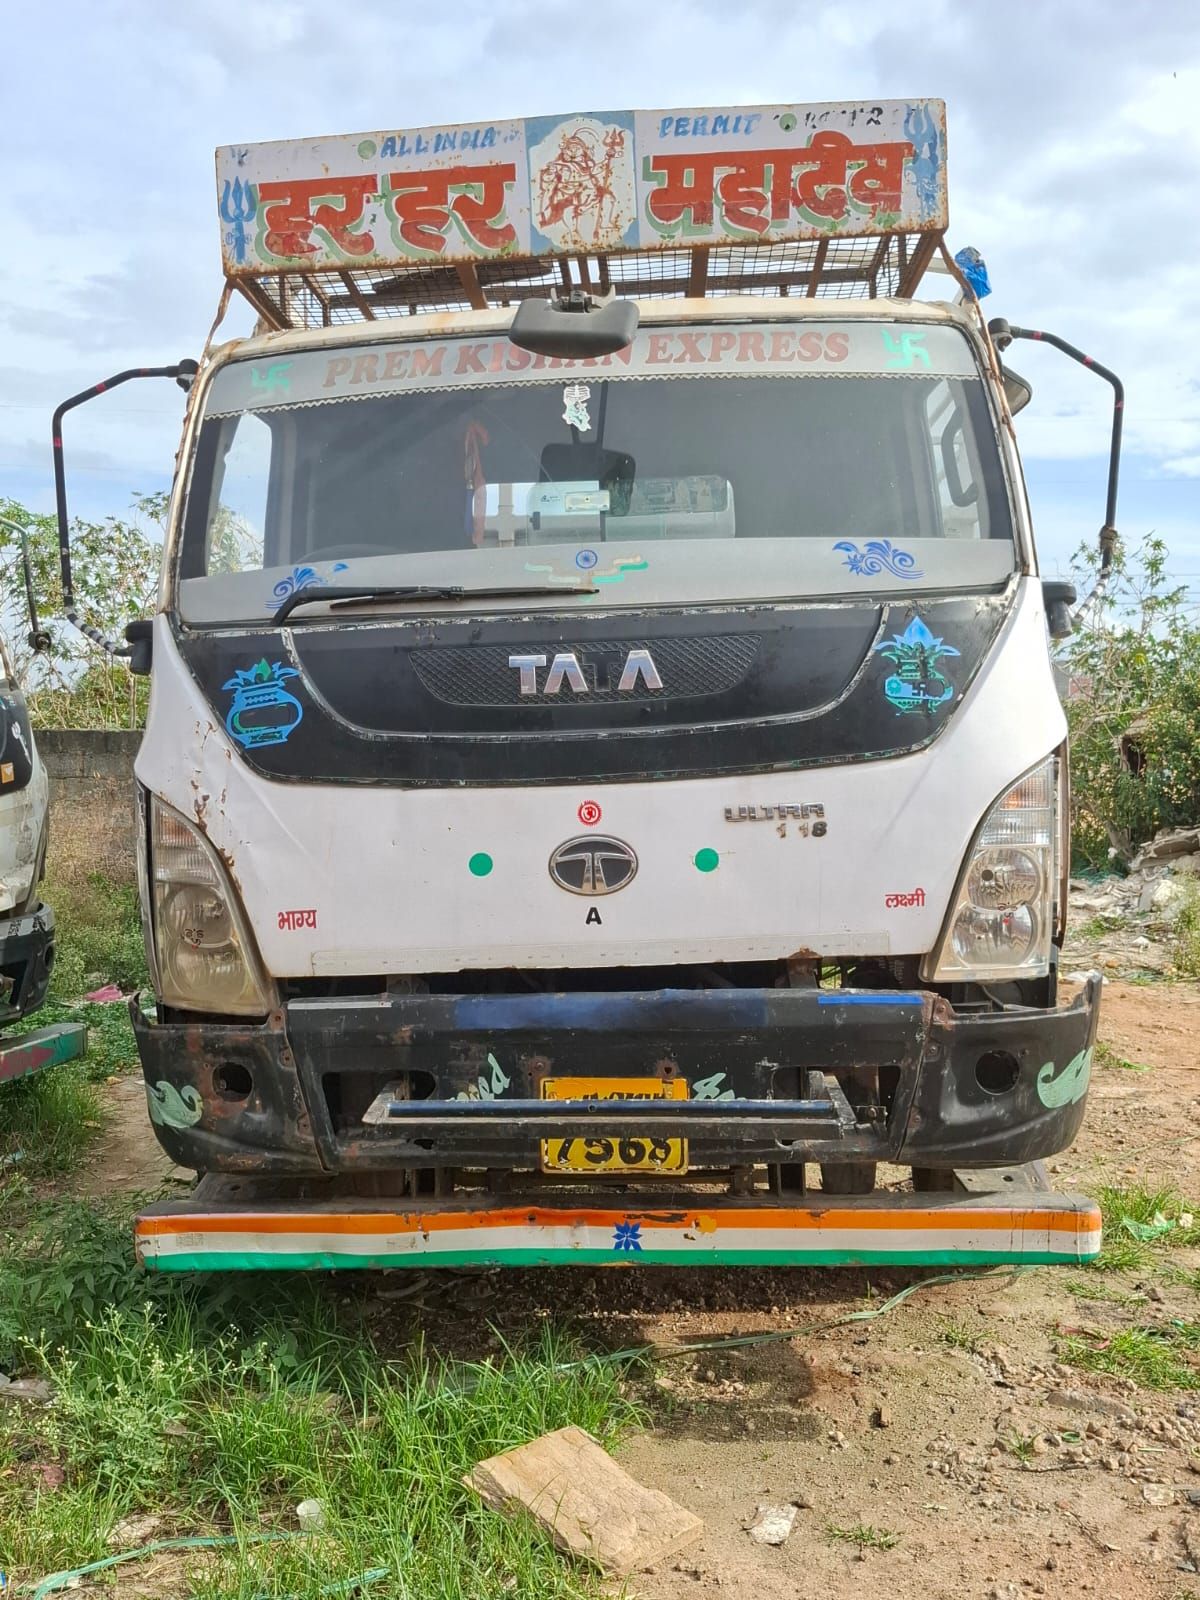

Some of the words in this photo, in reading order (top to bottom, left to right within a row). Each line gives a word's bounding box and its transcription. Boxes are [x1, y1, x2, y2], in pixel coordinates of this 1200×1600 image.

[380, 134, 428, 158] ALL
[433, 126, 497, 154] INDIA
[658, 113, 763, 138] PERMIT
[256, 173, 379, 260] हर
[388, 162, 518, 254] हर
[648, 130, 916, 236] महादेव
[322, 346, 448, 388] PREM
[644, 331, 851, 365] EXPRESS
[508, 648, 664, 697] TATA
[724, 802, 825, 823] ULTRA
[885, 887, 926, 908] लक्ष्मी
[278, 908, 318, 931] भाग्य
[585, 906, 603, 926] A
